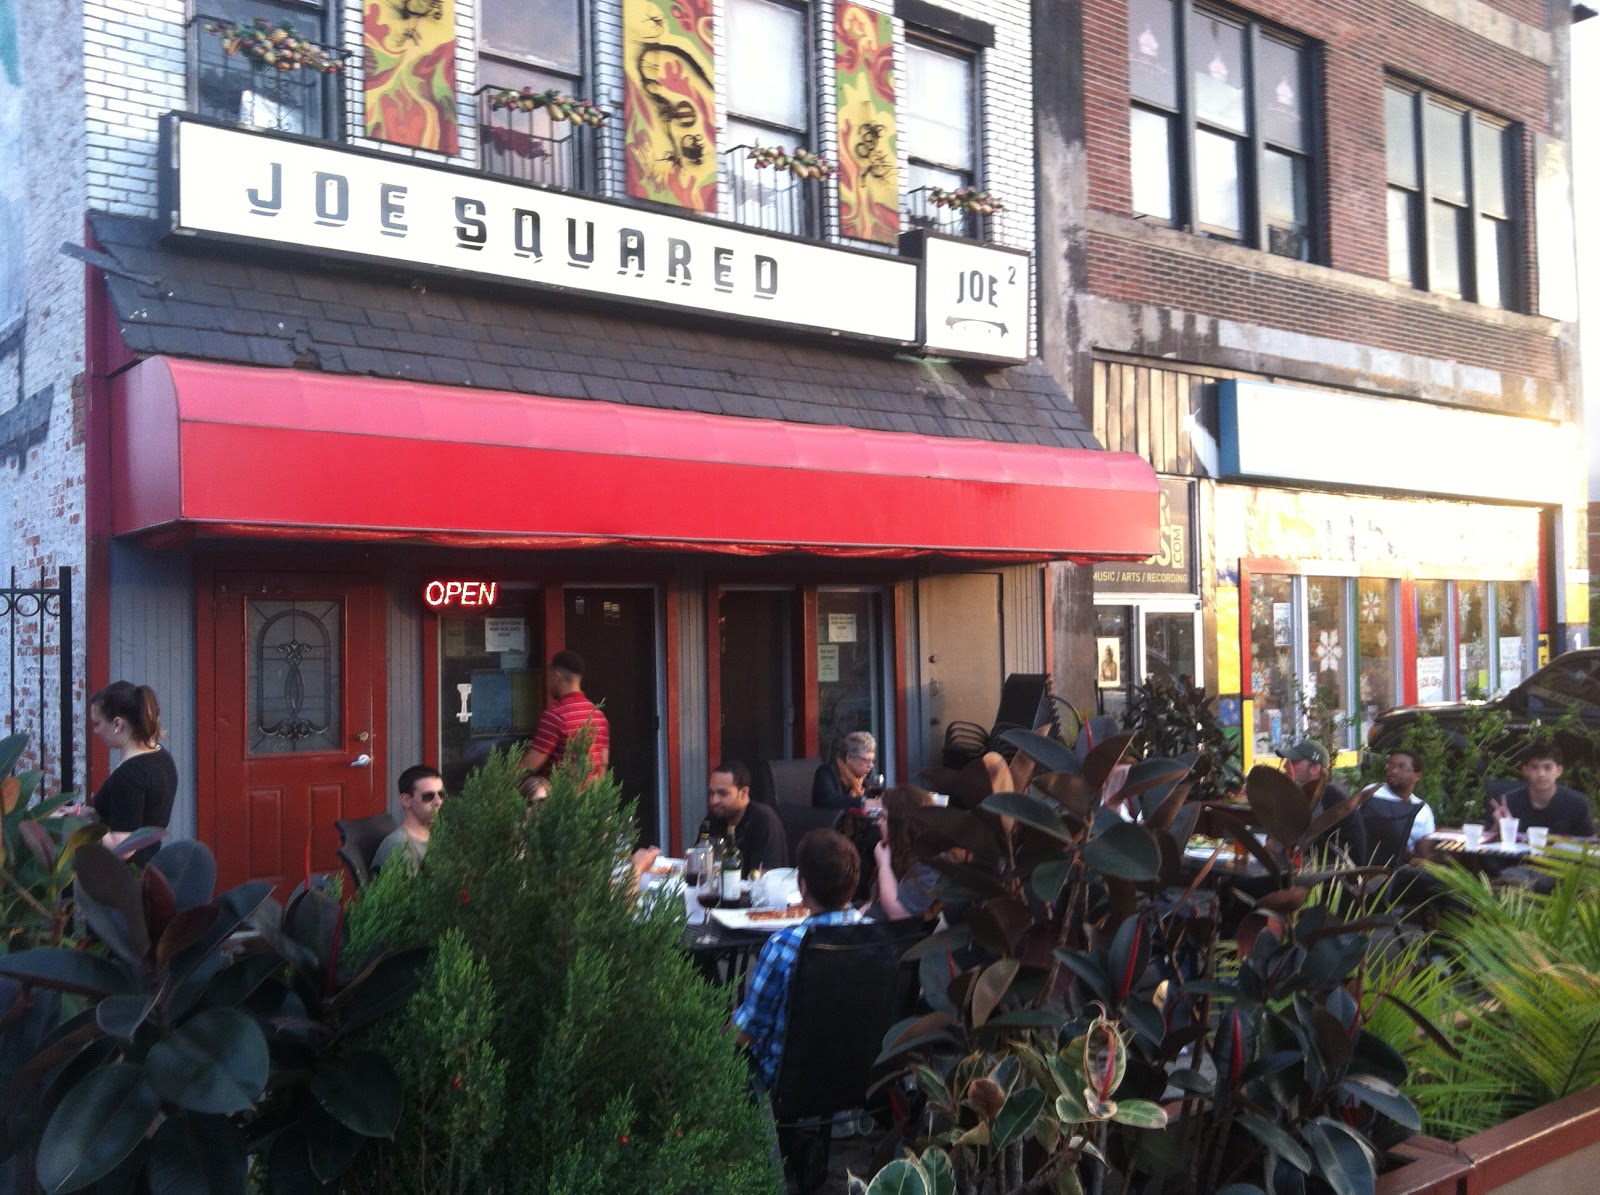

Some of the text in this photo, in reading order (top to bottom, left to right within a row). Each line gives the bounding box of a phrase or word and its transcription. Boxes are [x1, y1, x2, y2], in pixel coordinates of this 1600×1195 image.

[245, 162, 779, 300] JOE SQUARED
[1121, 572, 1141, 582] ARTS
[1146, 572, 1189, 583] RECORDING
[425, 580, 497, 606] OPEN
